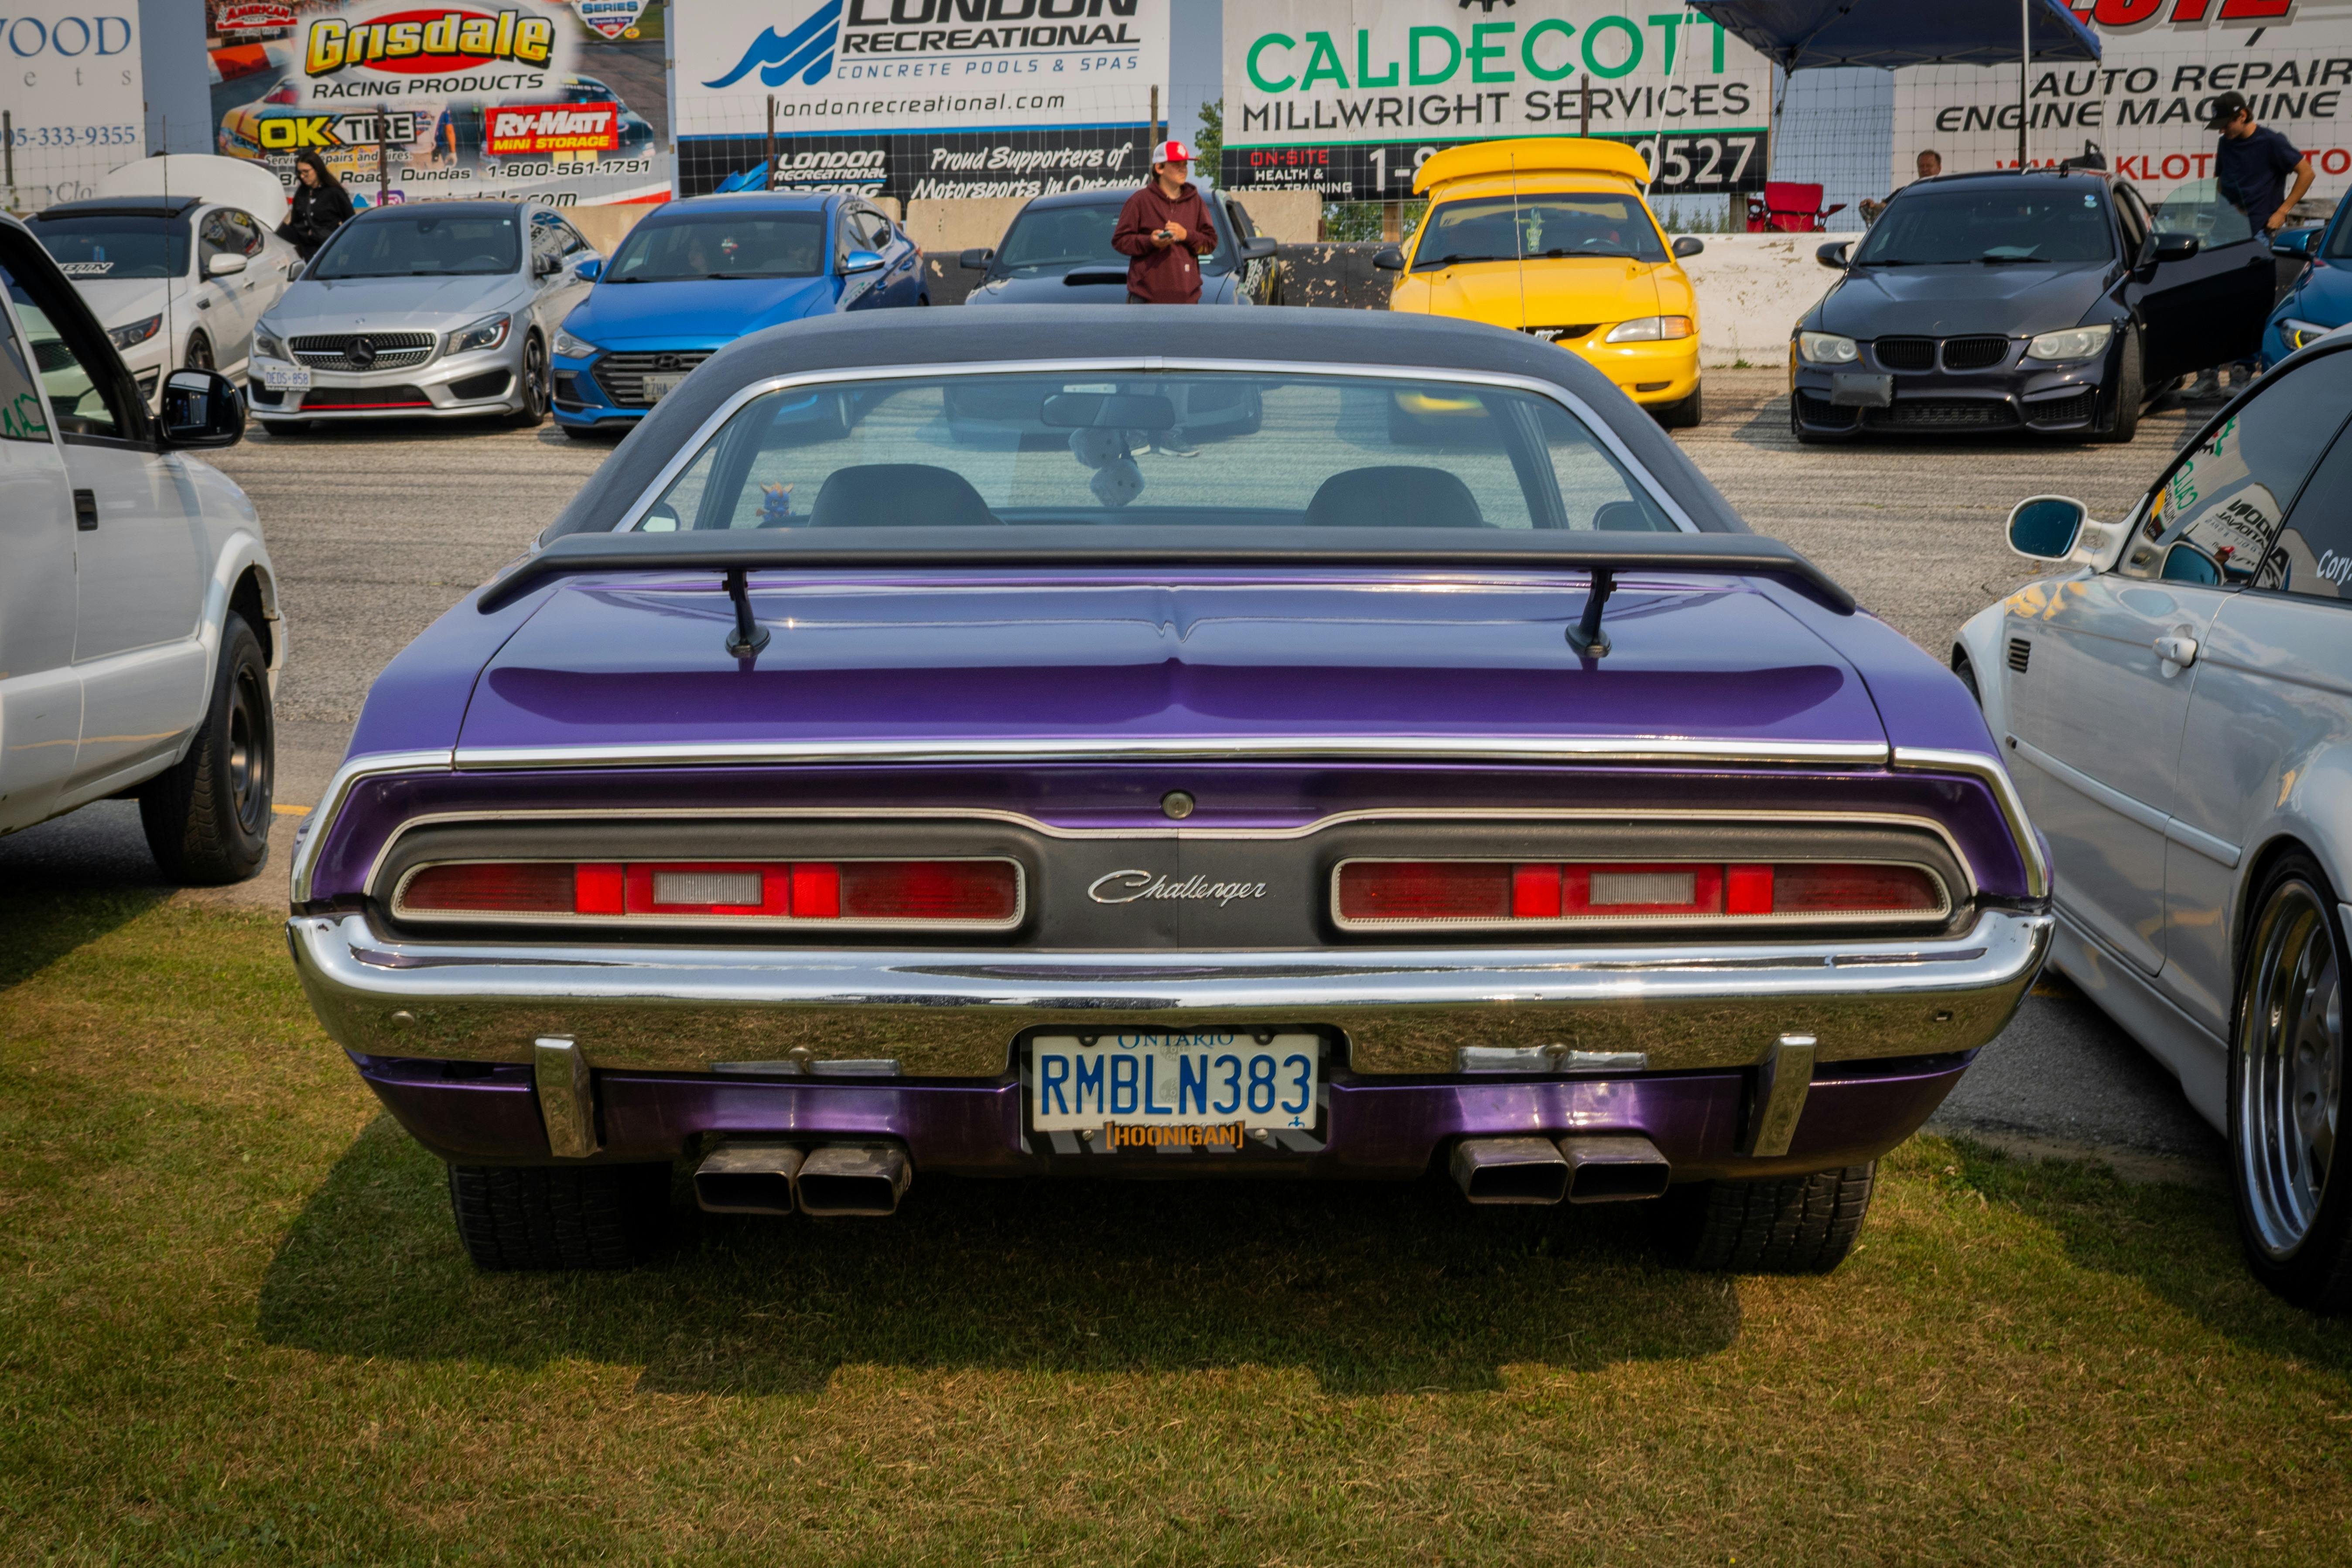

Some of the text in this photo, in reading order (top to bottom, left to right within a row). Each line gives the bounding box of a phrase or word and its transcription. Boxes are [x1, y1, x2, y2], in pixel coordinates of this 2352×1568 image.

[226, 5, 289, 22] AMERICAN
[0, 17, 131, 57] OOD
[305, 10, 554, 78] Grisdale
[842, 23, 1140, 54] RECREATIONAL
[1247, 13, 1724, 93] CALDECOTT
[838, 56, 1138, 79] CONCRETE POOLS & SPAS
[312, 73, 544, 99] RACING PRODUCTS
[2029, 66, 2158, 98] AUTO
[775, 93, 1064, 116] londonrecreational.com
[1244, 82, 1750, 132] MILLWRIGHT SERVICES
[1936, 101, 2102, 132] ENGINE
[261, 116, 331, 149] OK
[536, 136, 610, 149] STORAGE
[357, 152, 378, 162] and
[487, 159, 650, 178] 1-800-561-1791
[778, 150, 885, 170] LONDON
[931, 142, 1133, 174] Proud Supporters of
[1251, 150, 1329, 166] ON-SITE
[400, 167, 470, 182] Dundas
[1255, 168, 1323, 181] HEALTH &
[911, 178, 1042, 200] Motorsports
[1044, 176, 1061, 195] in
[1087, 869, 1266, 908] Challenger
[1041, 1054, 1311, 1115] RMBLN383
